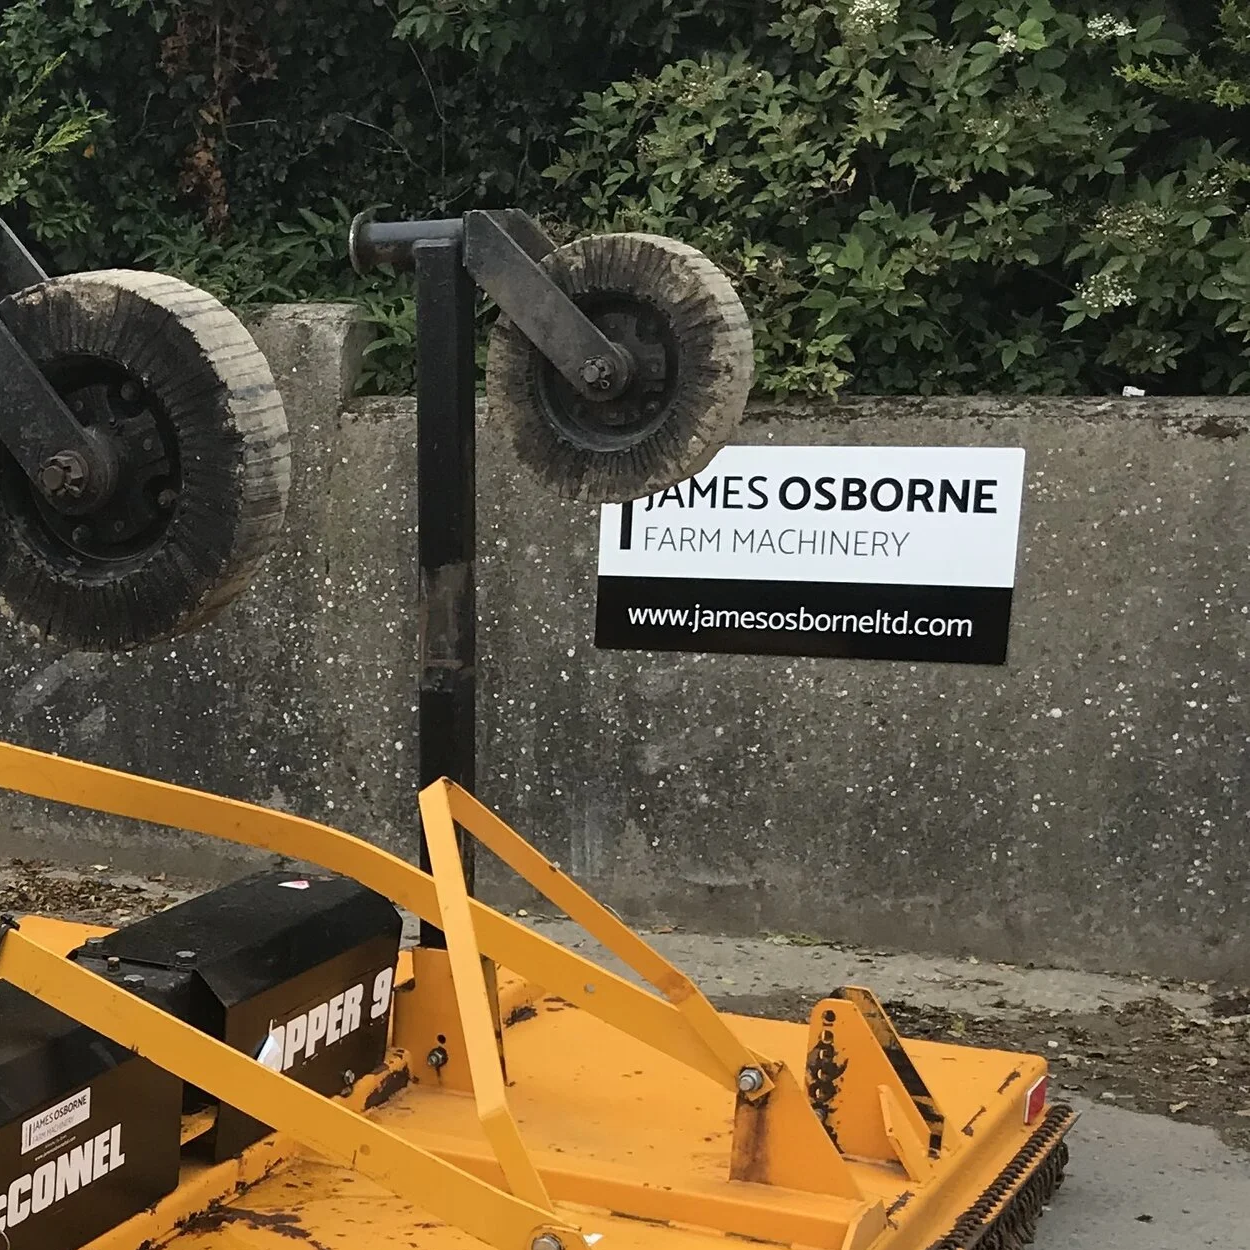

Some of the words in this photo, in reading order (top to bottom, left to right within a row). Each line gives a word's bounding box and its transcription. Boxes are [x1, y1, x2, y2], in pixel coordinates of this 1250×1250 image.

[778, 475, 998, 514] OSBORNE
[644, 526, 721, 553] FARM
[732, 528, 911, 557] MACHINERY
[627, 603, 973, 638] www.jamesosborneltd.com
[370, 966, 394, 1020] 9
[32, 1113, 55, 1133] JAMES
[53, 1094, 88, 1121] OSBORNE
